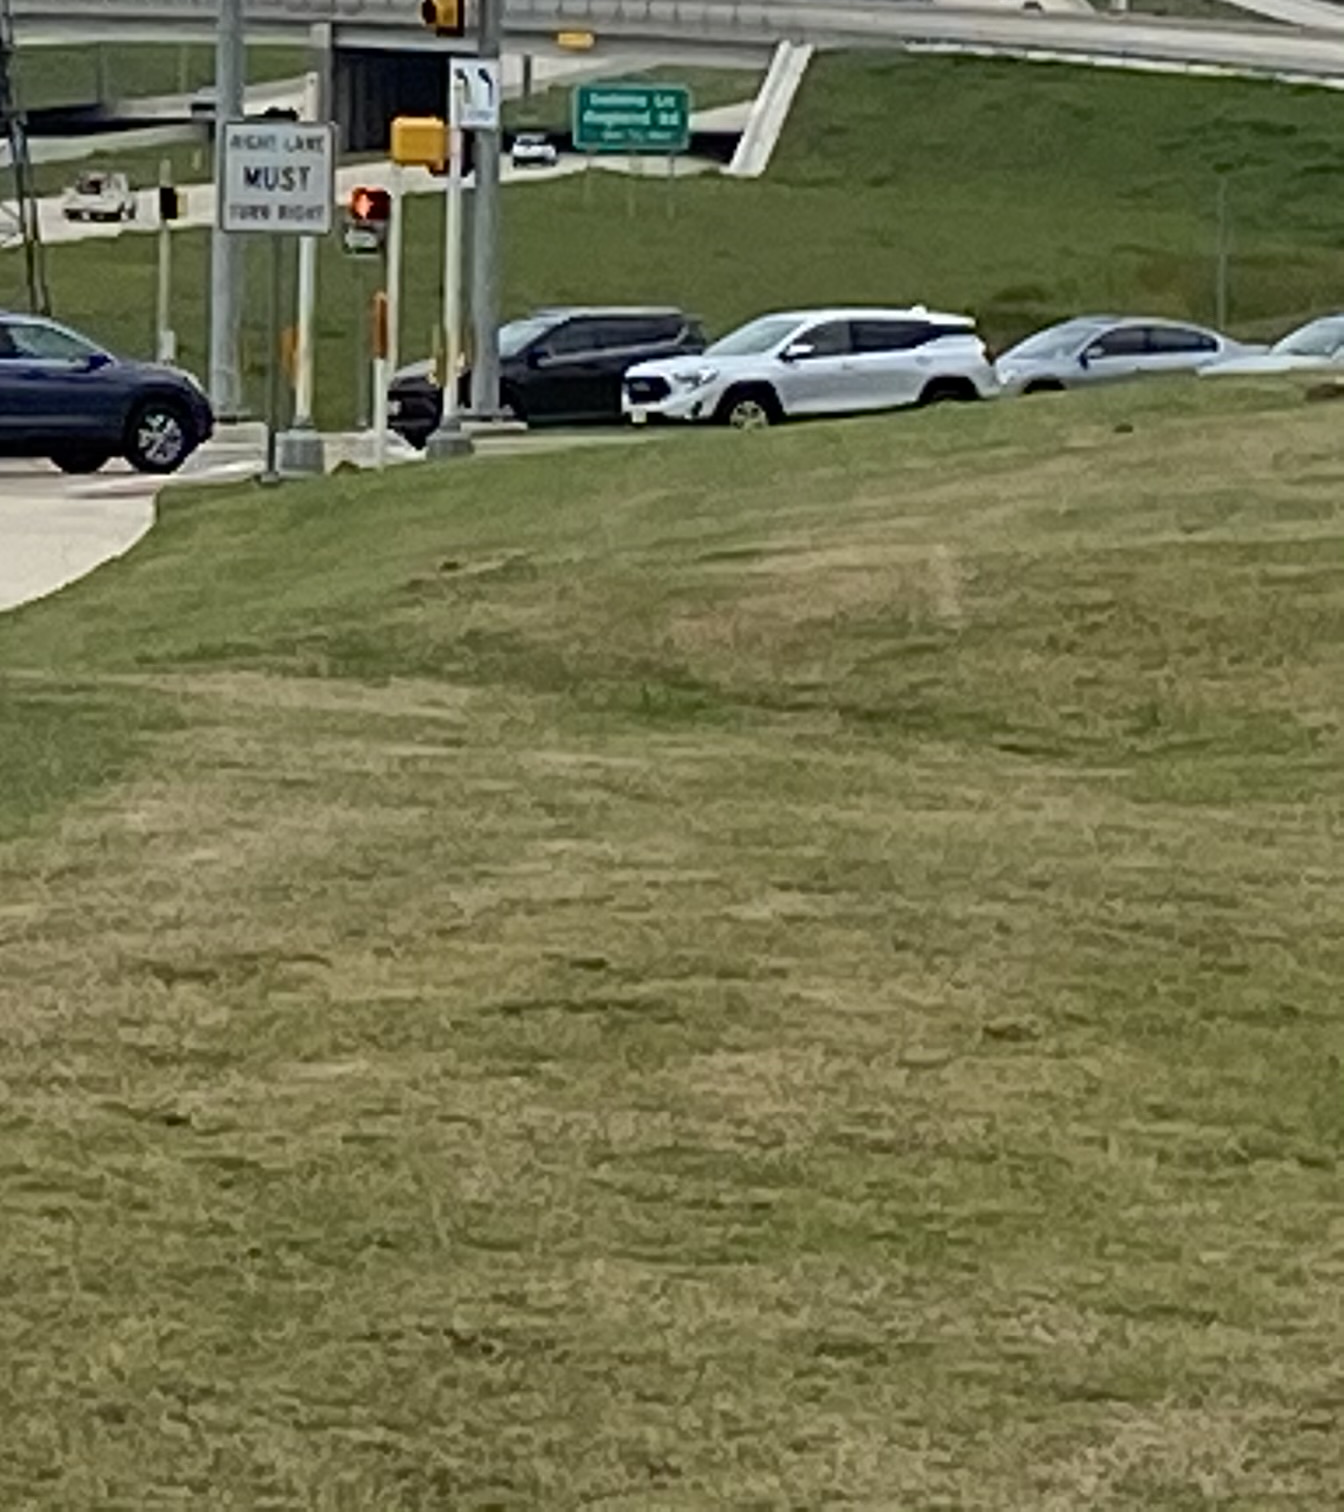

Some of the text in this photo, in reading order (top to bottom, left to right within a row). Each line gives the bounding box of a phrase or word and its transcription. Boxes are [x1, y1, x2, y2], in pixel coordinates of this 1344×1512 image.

[243, 165, 311, 192] MUST
[229, 204, 325, 223] TURN RIGHT
